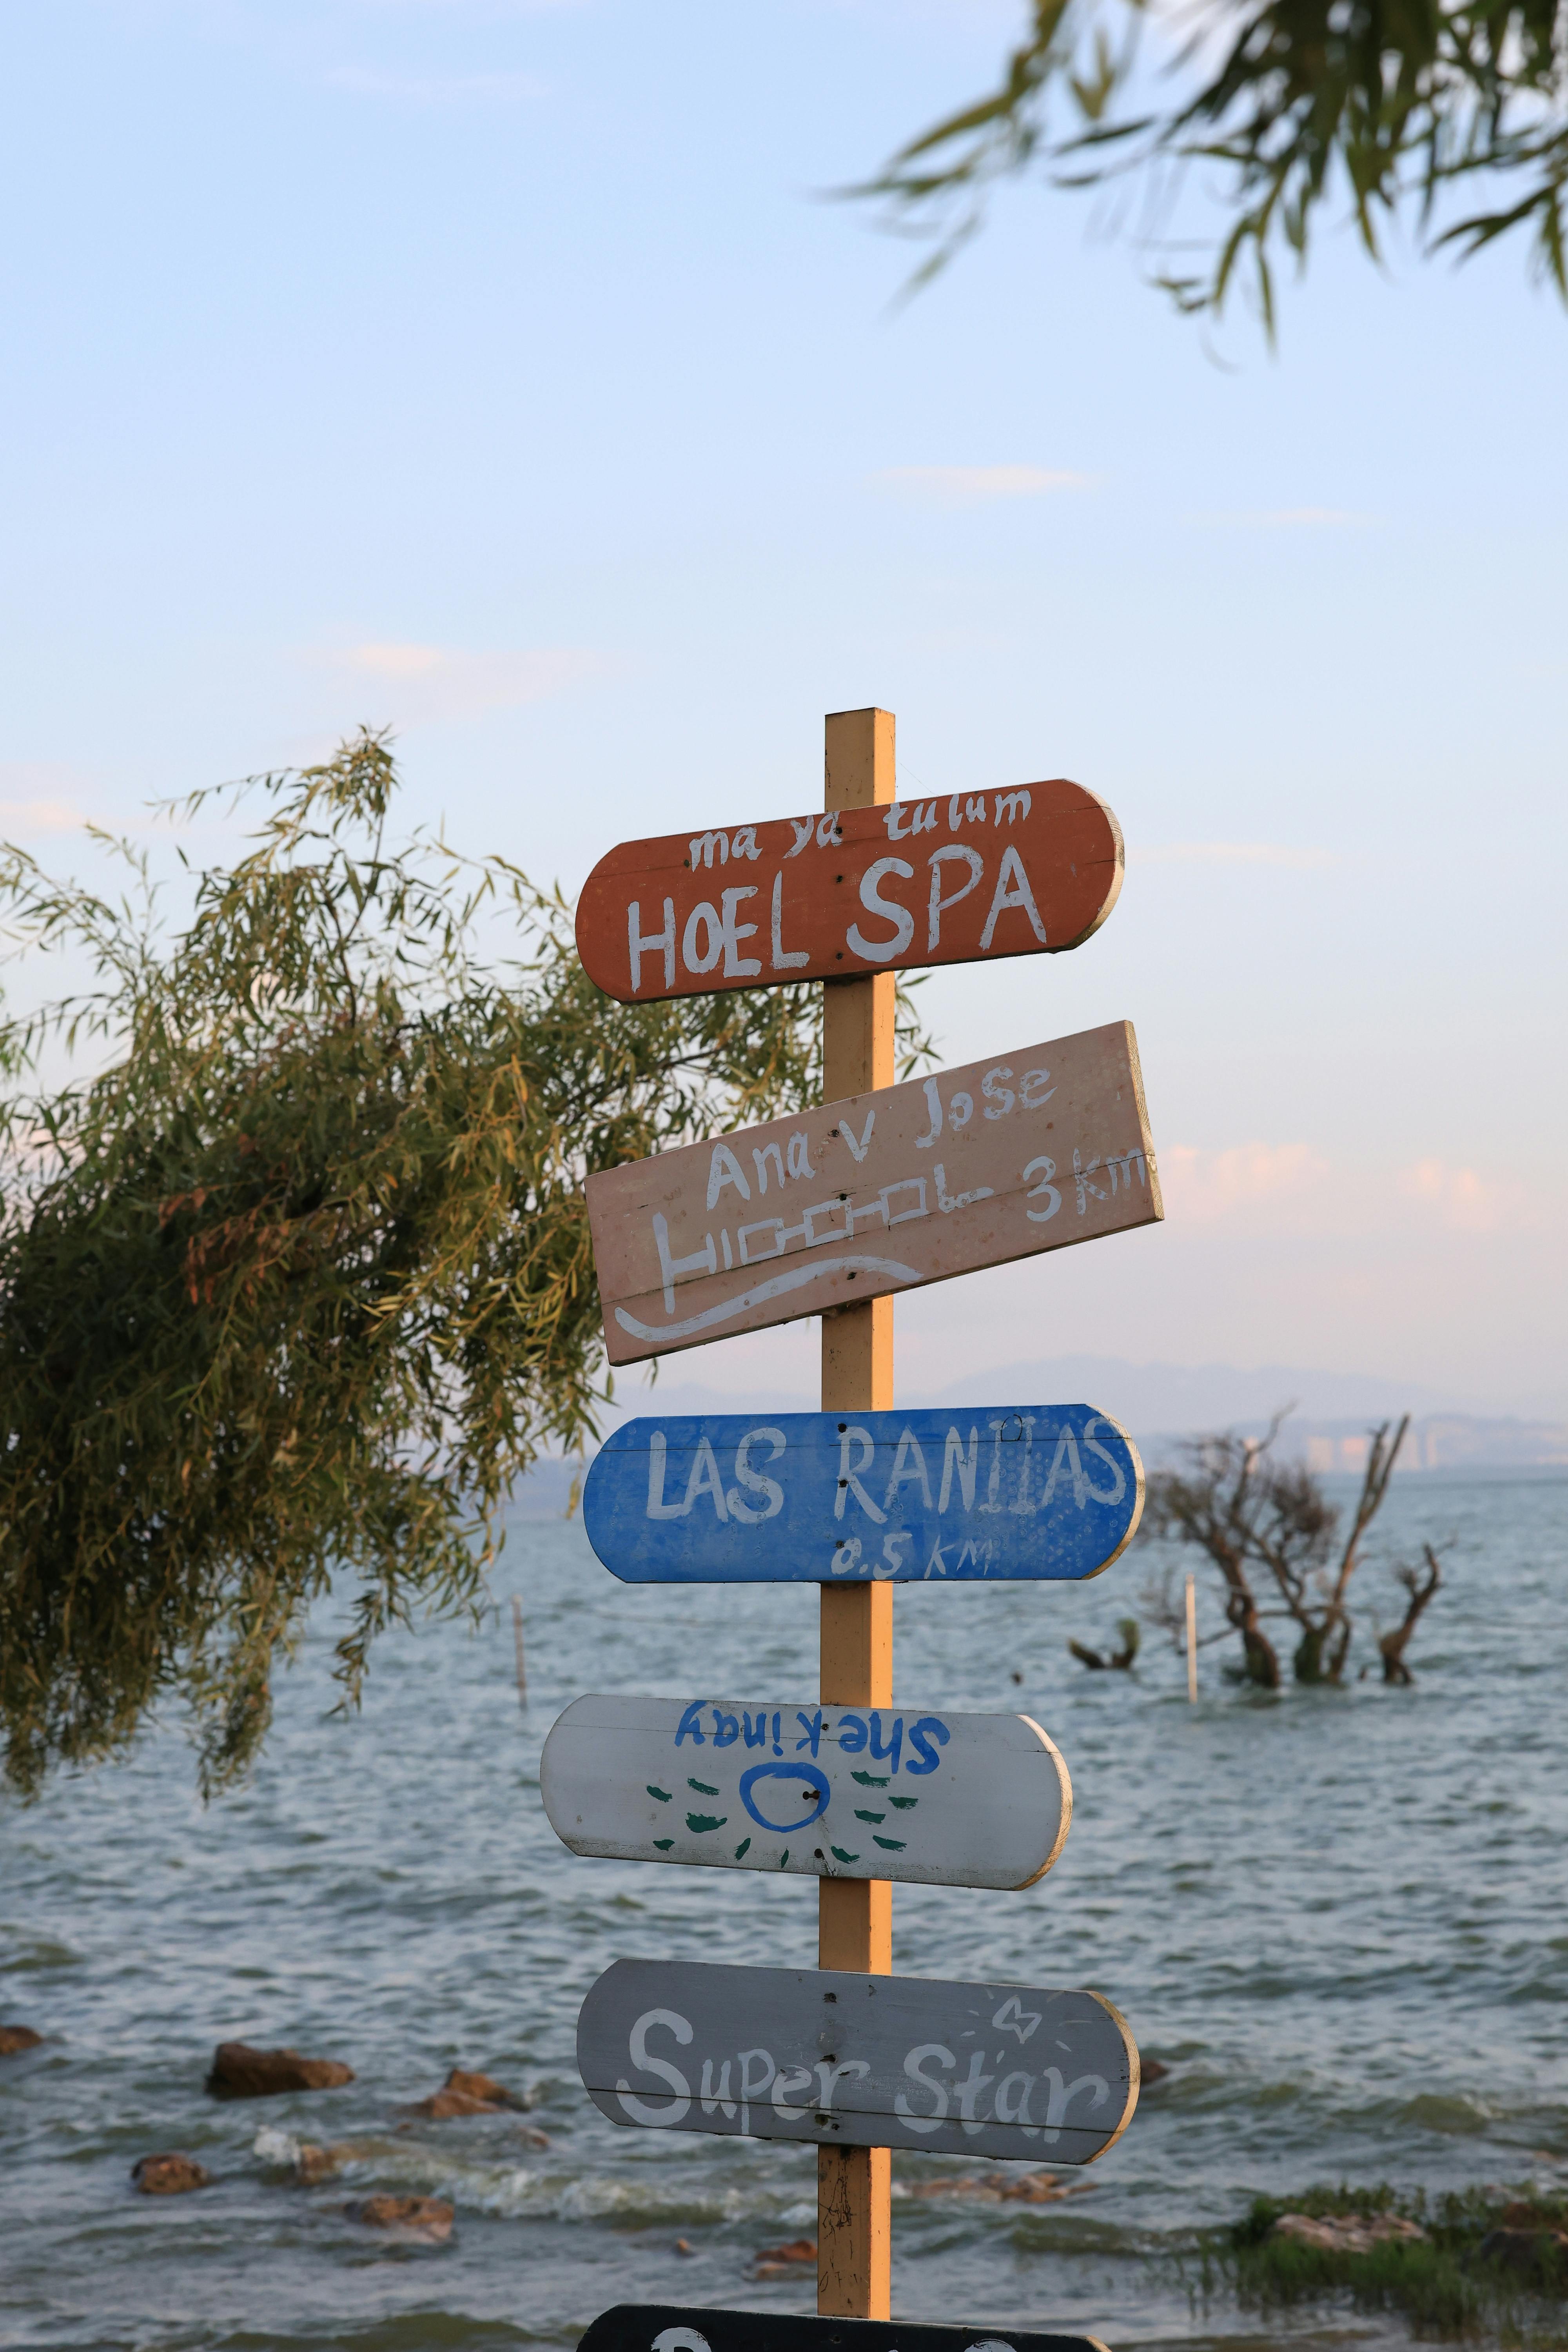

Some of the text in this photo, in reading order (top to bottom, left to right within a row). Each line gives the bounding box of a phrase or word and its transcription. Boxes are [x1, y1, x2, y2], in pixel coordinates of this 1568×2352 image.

[883, 789, 1033, 841] tulum
[628, 844, 1047, 994] HOEL SPA
[707, 1131, 816, 1210] Ana
[1023, 1156, 1062, 1222] 3
[1073, 1147, 1145, 1216] km
[646, 1428, 786, 1524] LAS
[831, 1533, 913, 1580] 0.5
[617, 2008, 1109, 2144] Super Star
